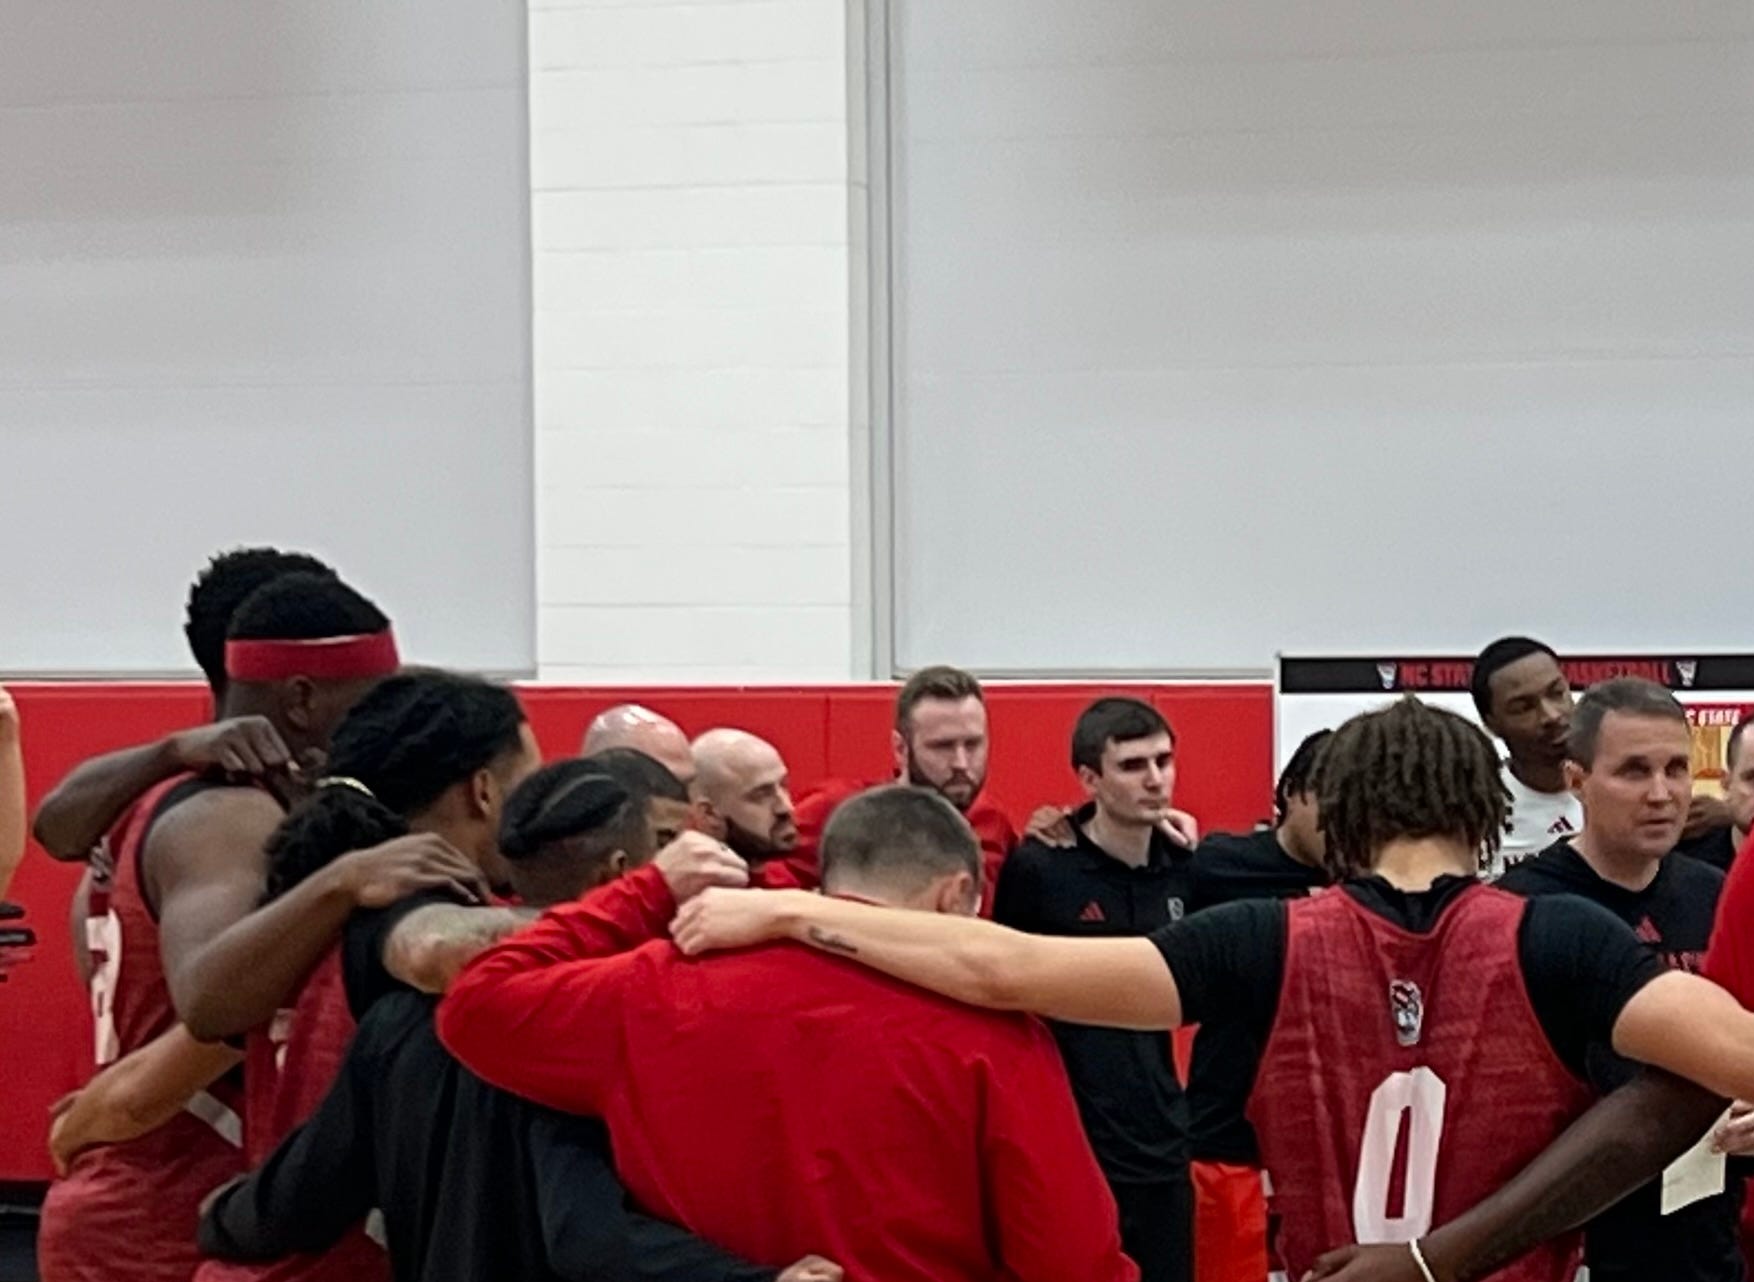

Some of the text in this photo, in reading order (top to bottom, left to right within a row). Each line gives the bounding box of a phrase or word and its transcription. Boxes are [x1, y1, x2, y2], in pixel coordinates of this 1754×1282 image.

[1401, 662, 1428, 687] NC
[1560, 661, 1669, 686] ASKETBALL
[1353, 1066, 1446, 1245] 0
